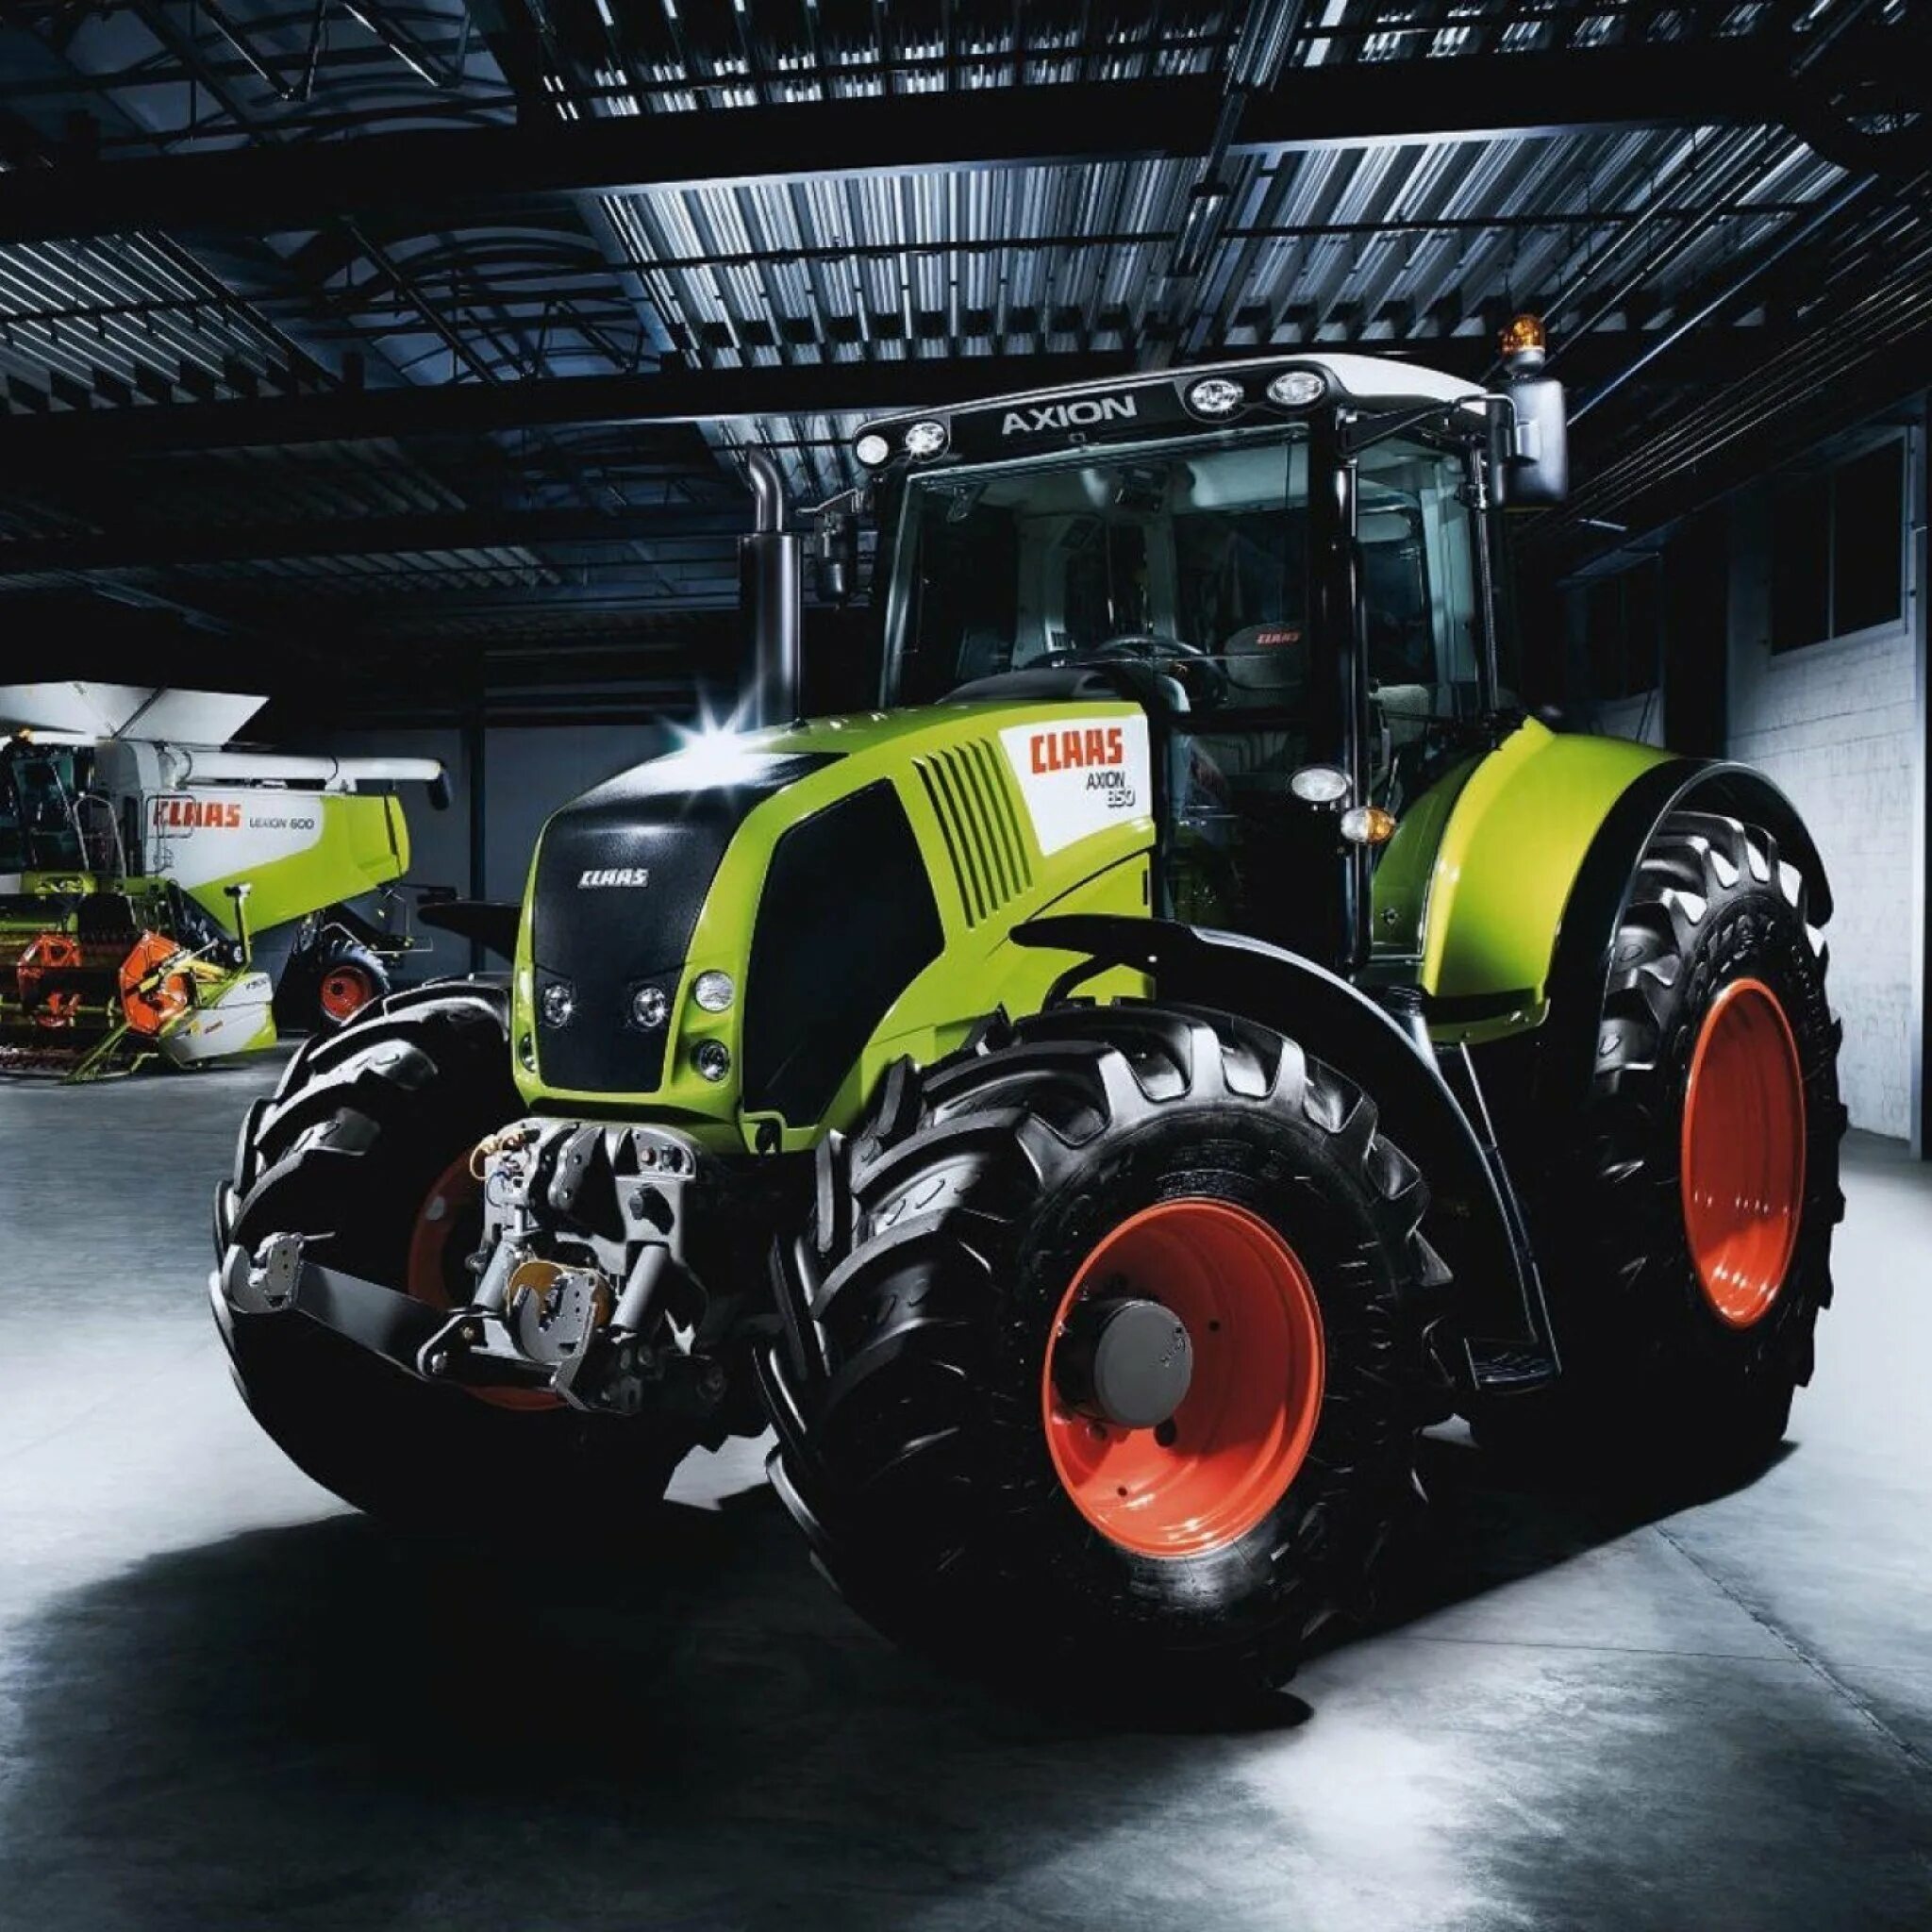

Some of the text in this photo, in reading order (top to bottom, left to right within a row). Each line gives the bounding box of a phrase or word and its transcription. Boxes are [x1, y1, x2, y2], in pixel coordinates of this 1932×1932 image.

[1002, 395, 1137, 435] AXION
[1030, 728, 1124, 774] CLAAS
[1087, 772, 1125, 791] AXION
[153, 801, 242, 827] CLAAS
[577, 868, 649, 888] CLAAS
